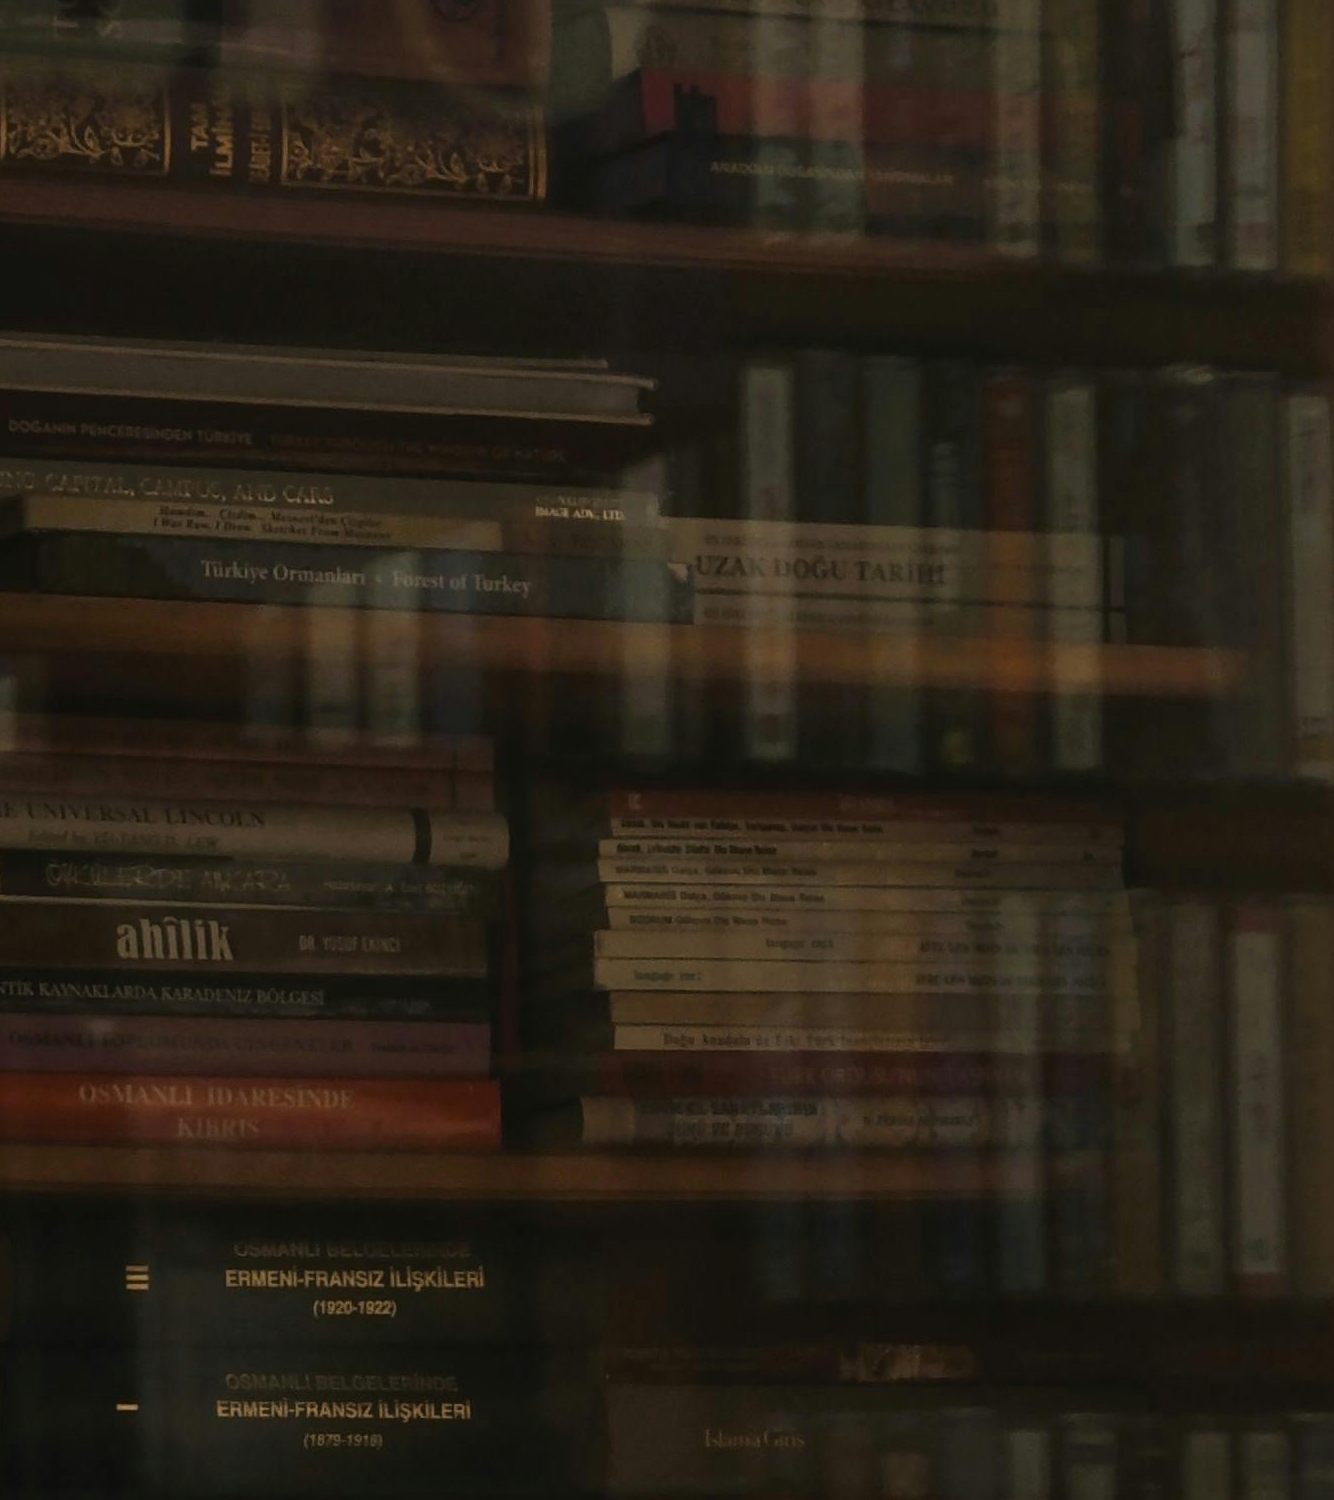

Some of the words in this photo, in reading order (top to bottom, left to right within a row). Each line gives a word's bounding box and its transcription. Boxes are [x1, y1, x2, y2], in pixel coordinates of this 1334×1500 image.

[199, 558, 268, 587] Türkiye
[272, 561, 367, 589] Ormanları
[473, 571, 532, 599] Turkey
[115, 913, 235, 964] ahîlik
[77, 1080, 194, 1110] OSMANLI
[205, 1078, 357, 1112] İDARESİNDE
[176, 1115, 260, 1143] KIBRIS
[224, 1265, 385, 1291] ERMENİ-FRANSIZ
[389, 1264, 486, 1294] İLİŞKİLERİ
[215, 1397, 374, 1421] ERMENİ-FRANSIZ
[378, 1397, 473, 1425] İLİŞKİLERİ
